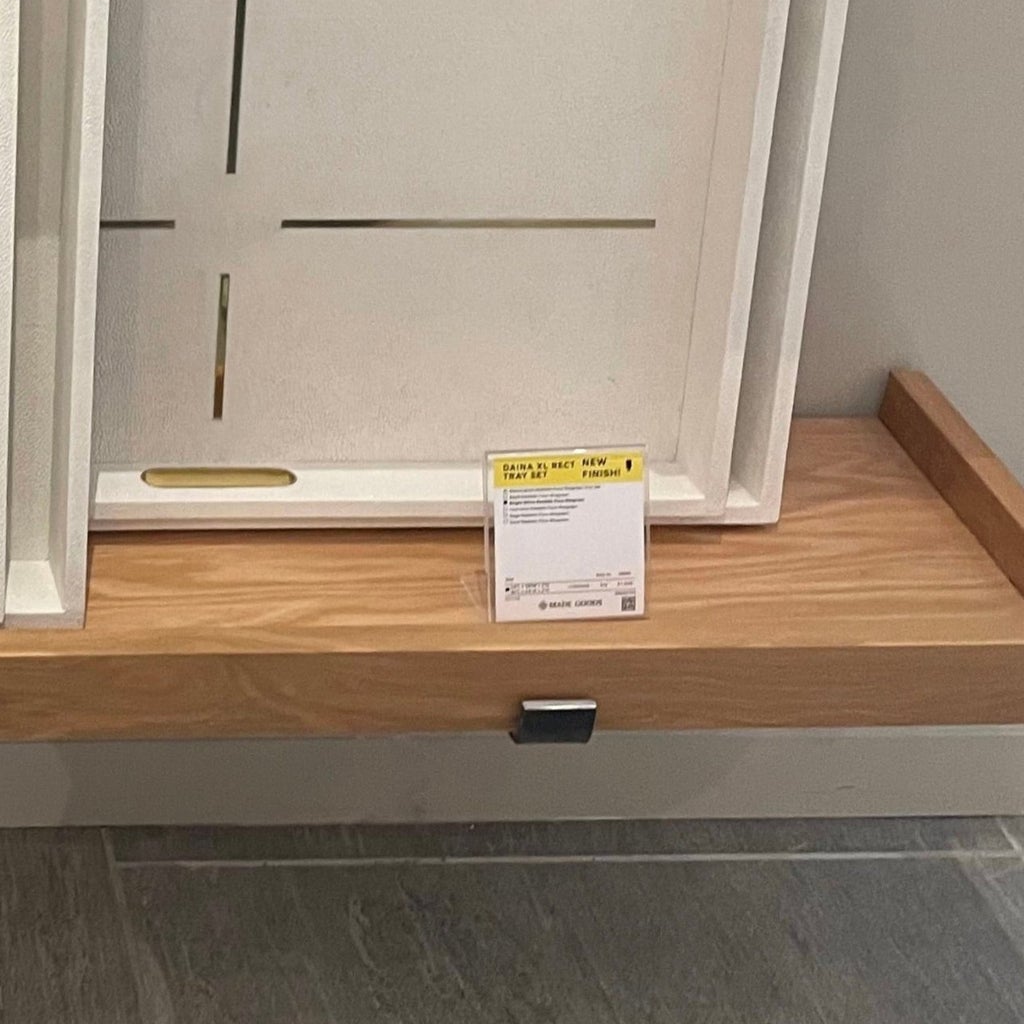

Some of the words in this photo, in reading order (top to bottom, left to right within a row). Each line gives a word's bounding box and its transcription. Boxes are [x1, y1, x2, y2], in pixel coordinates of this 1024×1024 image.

[502, 463, 533, 472] DAINA
[537, 462, 548, 470] XL
[551, 460, 575, 469] RECT
[582, 457, 607, 467] NEW
[503, 472, 527, 480] TRAY
[530, 470, 548, 479] SET
[582, 469, 621, 479] FINISH!
